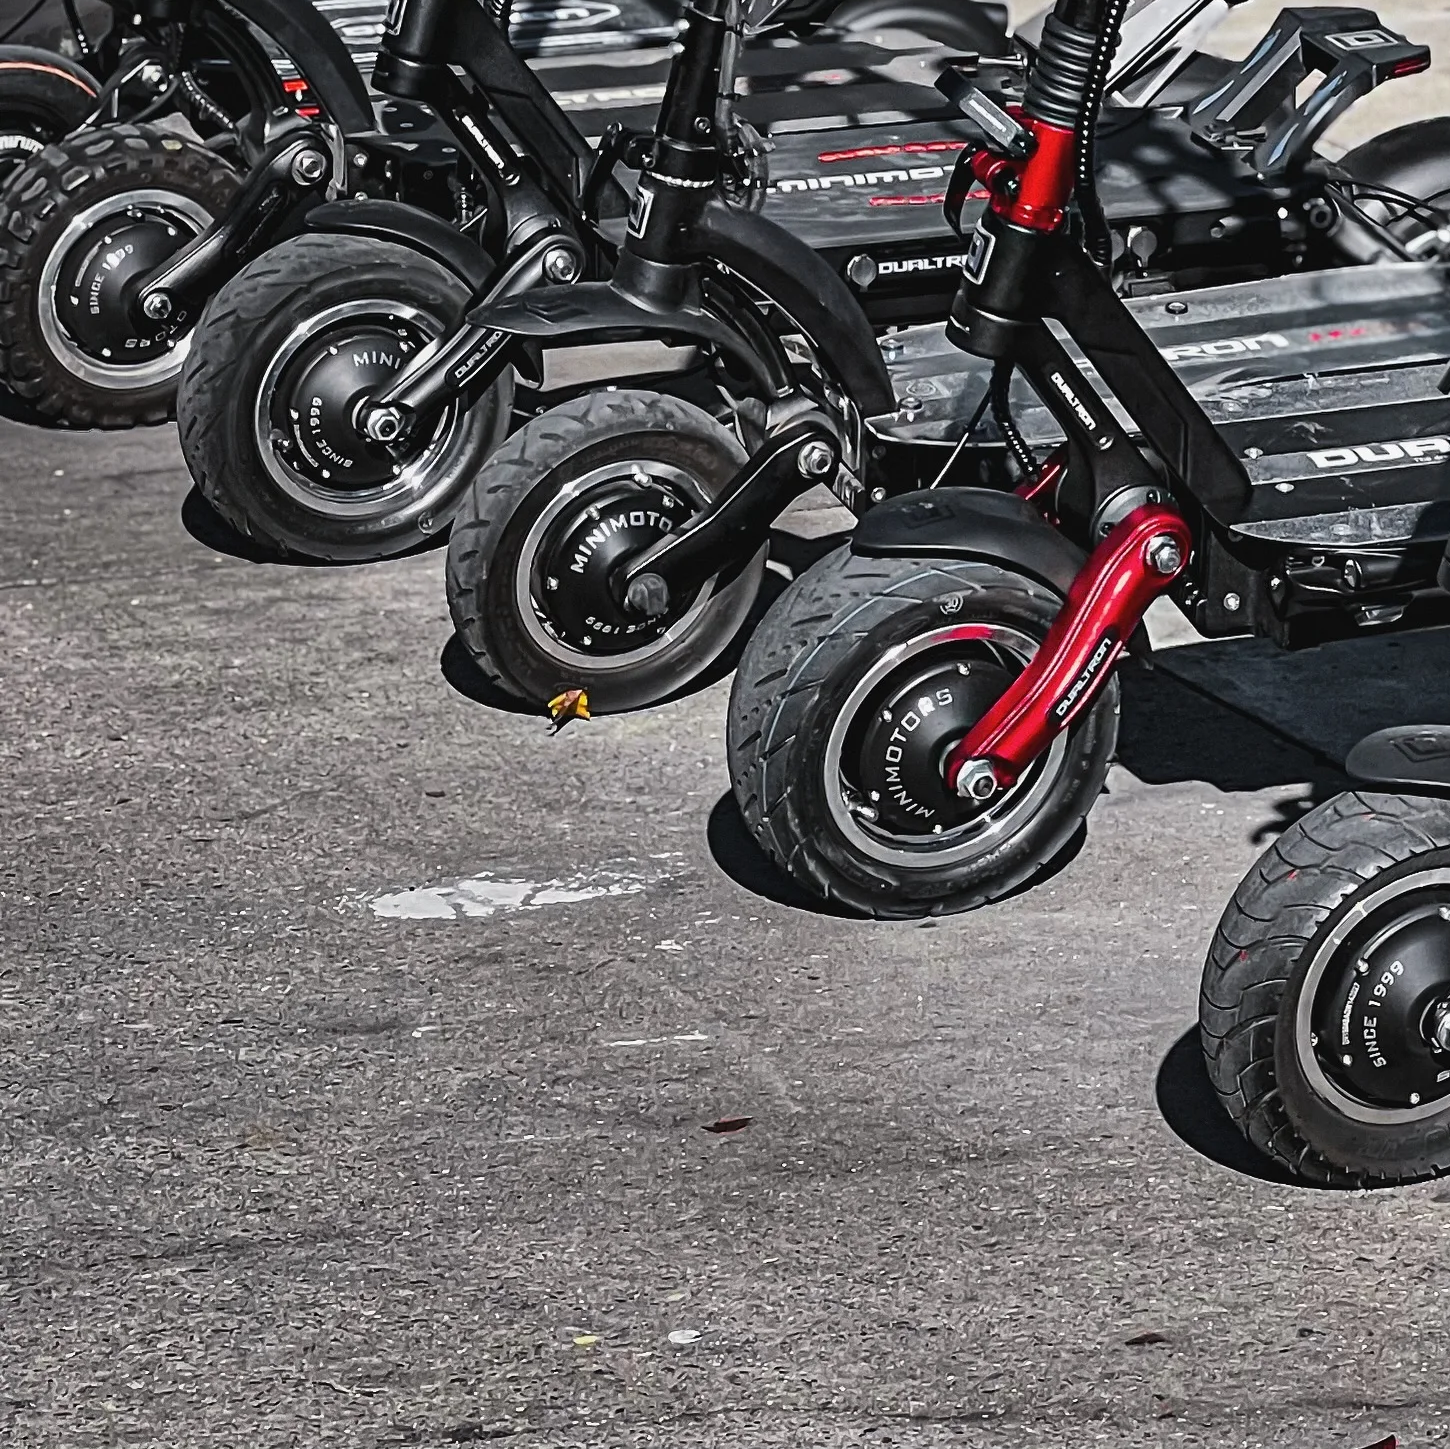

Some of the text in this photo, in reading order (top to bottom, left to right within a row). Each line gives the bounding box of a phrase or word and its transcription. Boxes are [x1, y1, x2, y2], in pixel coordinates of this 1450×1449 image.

[878, 254, 969, 274] DUALTR
[454, 331, 503, 379] DUALTRO
[309, 396, 323, 435] 1999
[1051, 372, 1096, 430] DUALTRON
[1056, 638, 1112, 716] DUALTRON
[884, 688, 953, 818] MINIMOTORS
[1363, 961, 1404, 1068] SINCE 1999
